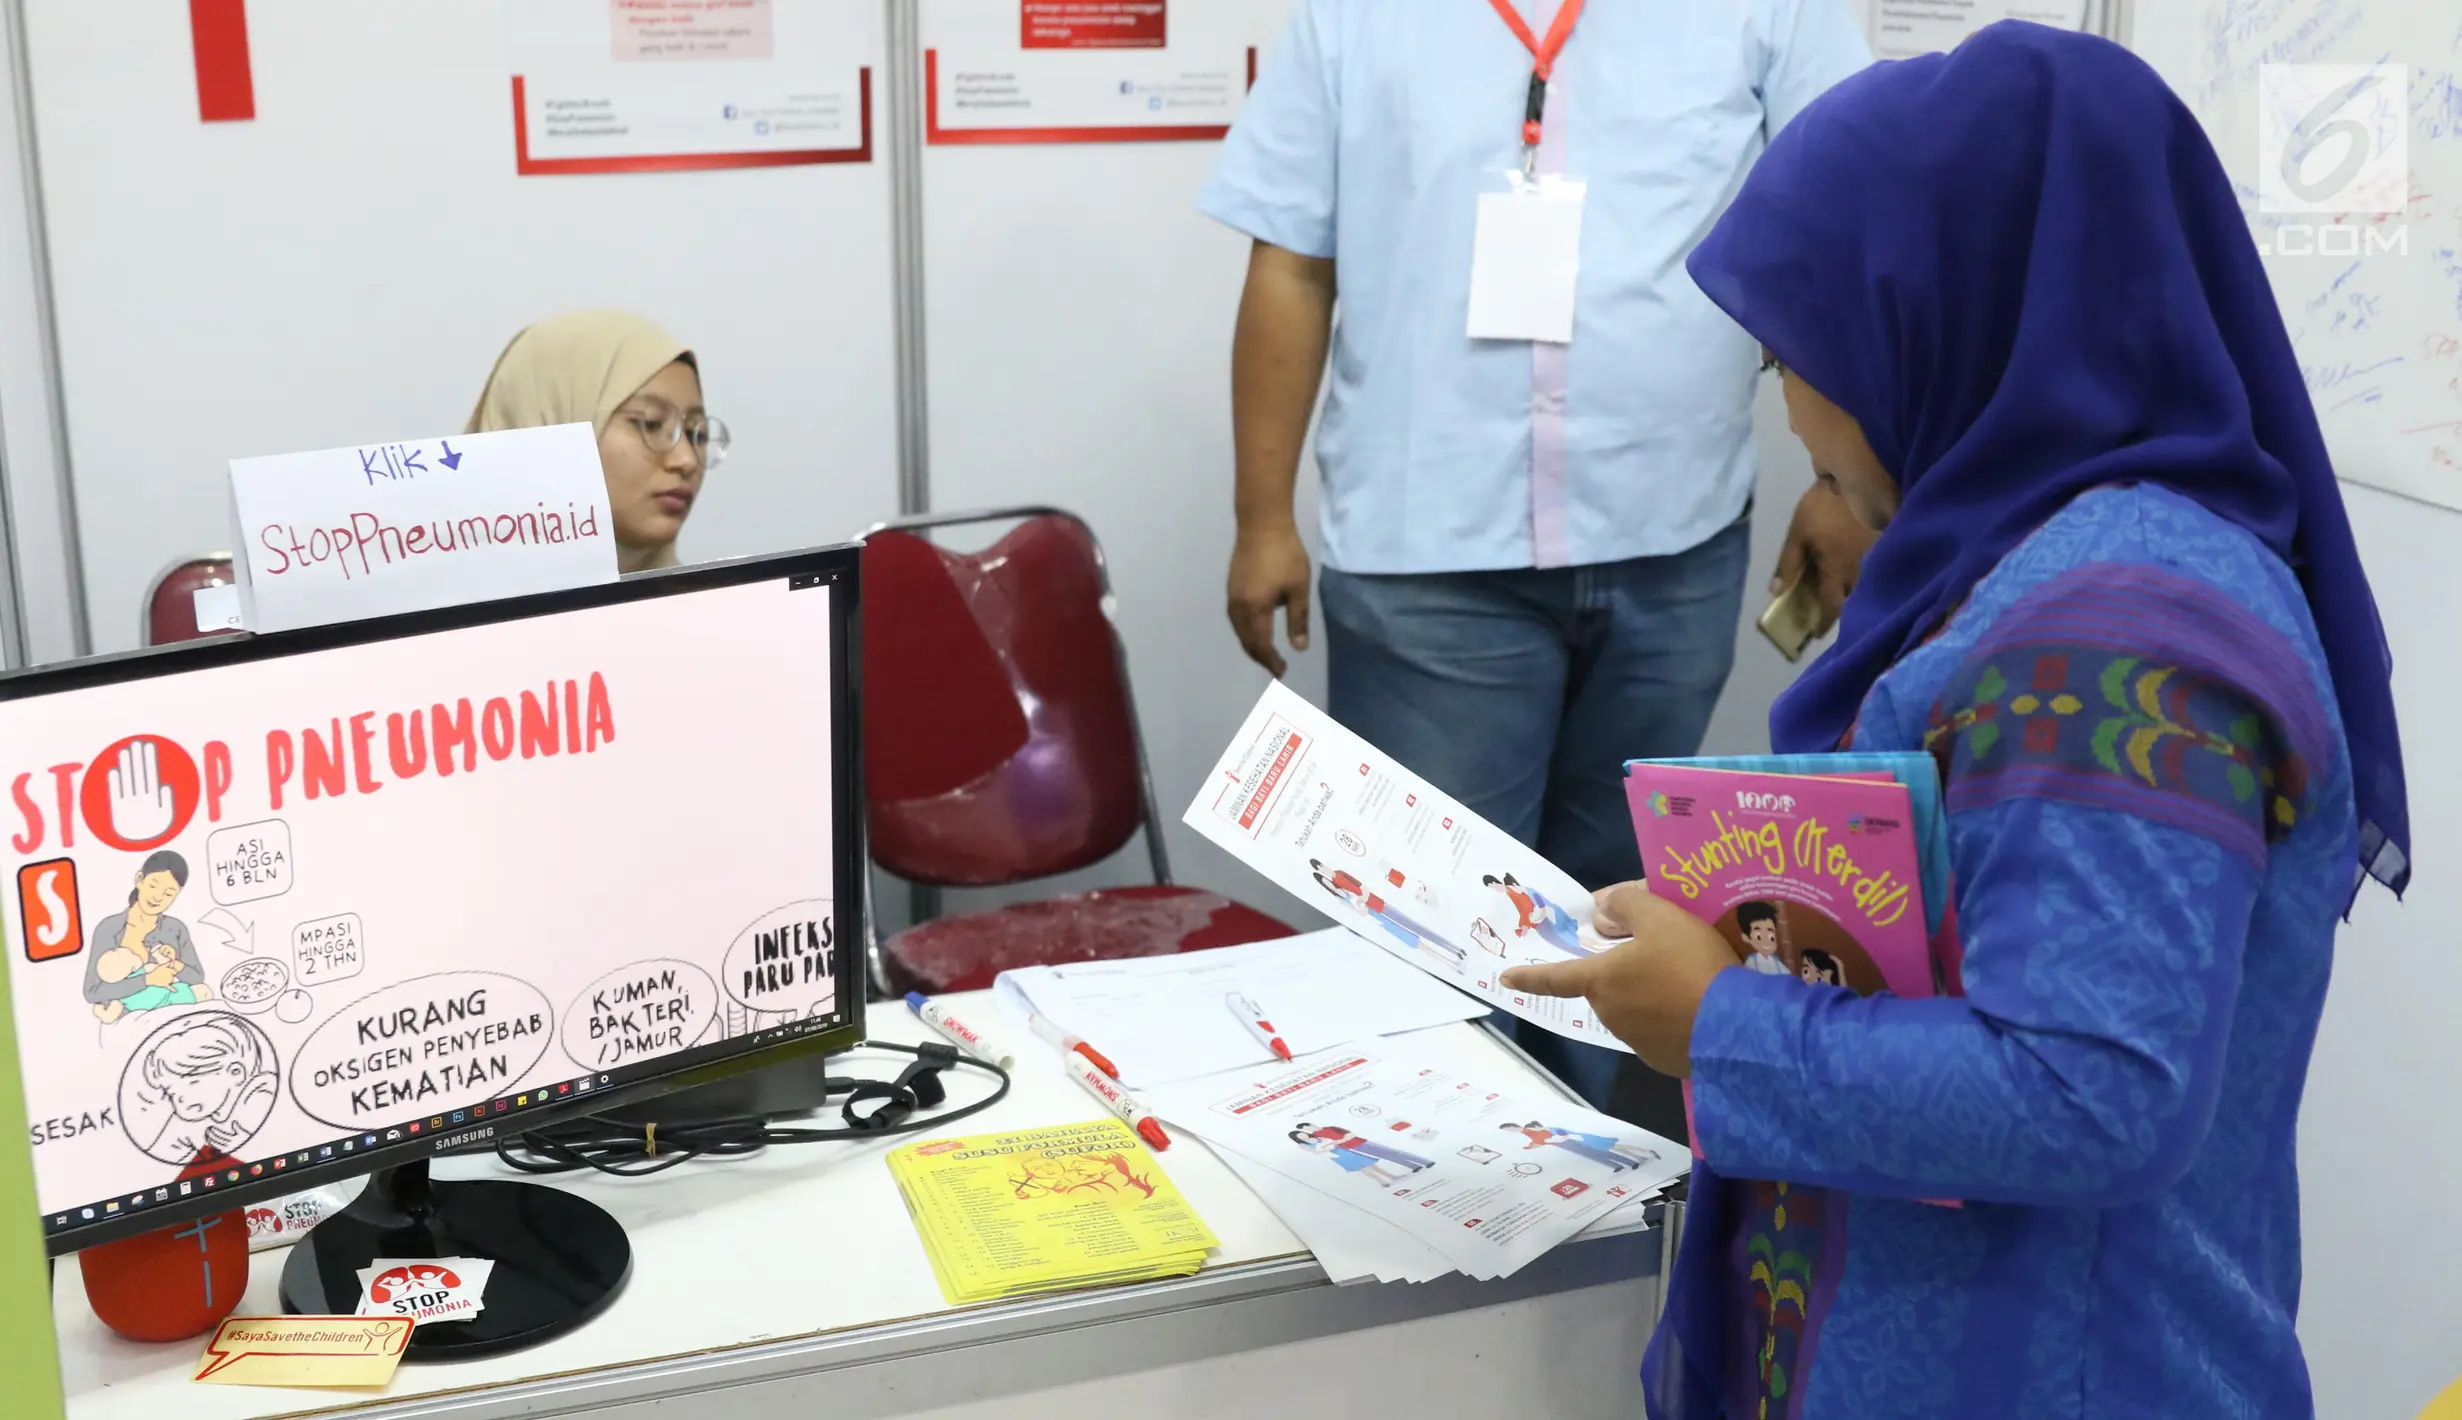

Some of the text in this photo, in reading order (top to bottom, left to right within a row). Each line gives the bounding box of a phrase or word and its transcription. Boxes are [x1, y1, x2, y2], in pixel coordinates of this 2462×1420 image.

[359, 444, 428, 486] Klik
[261, 502, 600, 580] StopPneumonia.id
[11, 671, 616, 855] STOP PNEUMONIA
[216, 850, 285, 876] HINGGA
[236, 838, 264, 856] ASI
[1660, 809, 1785, 899] Stunting
[226, 868, 277, 887] 6 BLN
[34, 866, 68, 951] S
[298, 937, 356, 960] HINGGA
[300, 922, 351, 945] MPASI
[305, 951, 357, 975] 2 THN
[743, 960, 795, 999] PARU
[357, 989, 487, 1046] KURANG
[313, 1013, 543, 1088] OKSIGEN PENYEBAB
[351, 1054, 508, 1116] KEMATIAN
[1085, 1070, 1120, 1103] SNOWMAN
[30, 1097, 115, 1146] SESAK
[435, 1127, 494, 1150] SAMSUNG
[953, 1131, 1129, 1161] SUSU FORMULA
[393, 1291, 450, 1314] STOP
[226, 1327, 364, 1344] #SayaSavetheChildren
